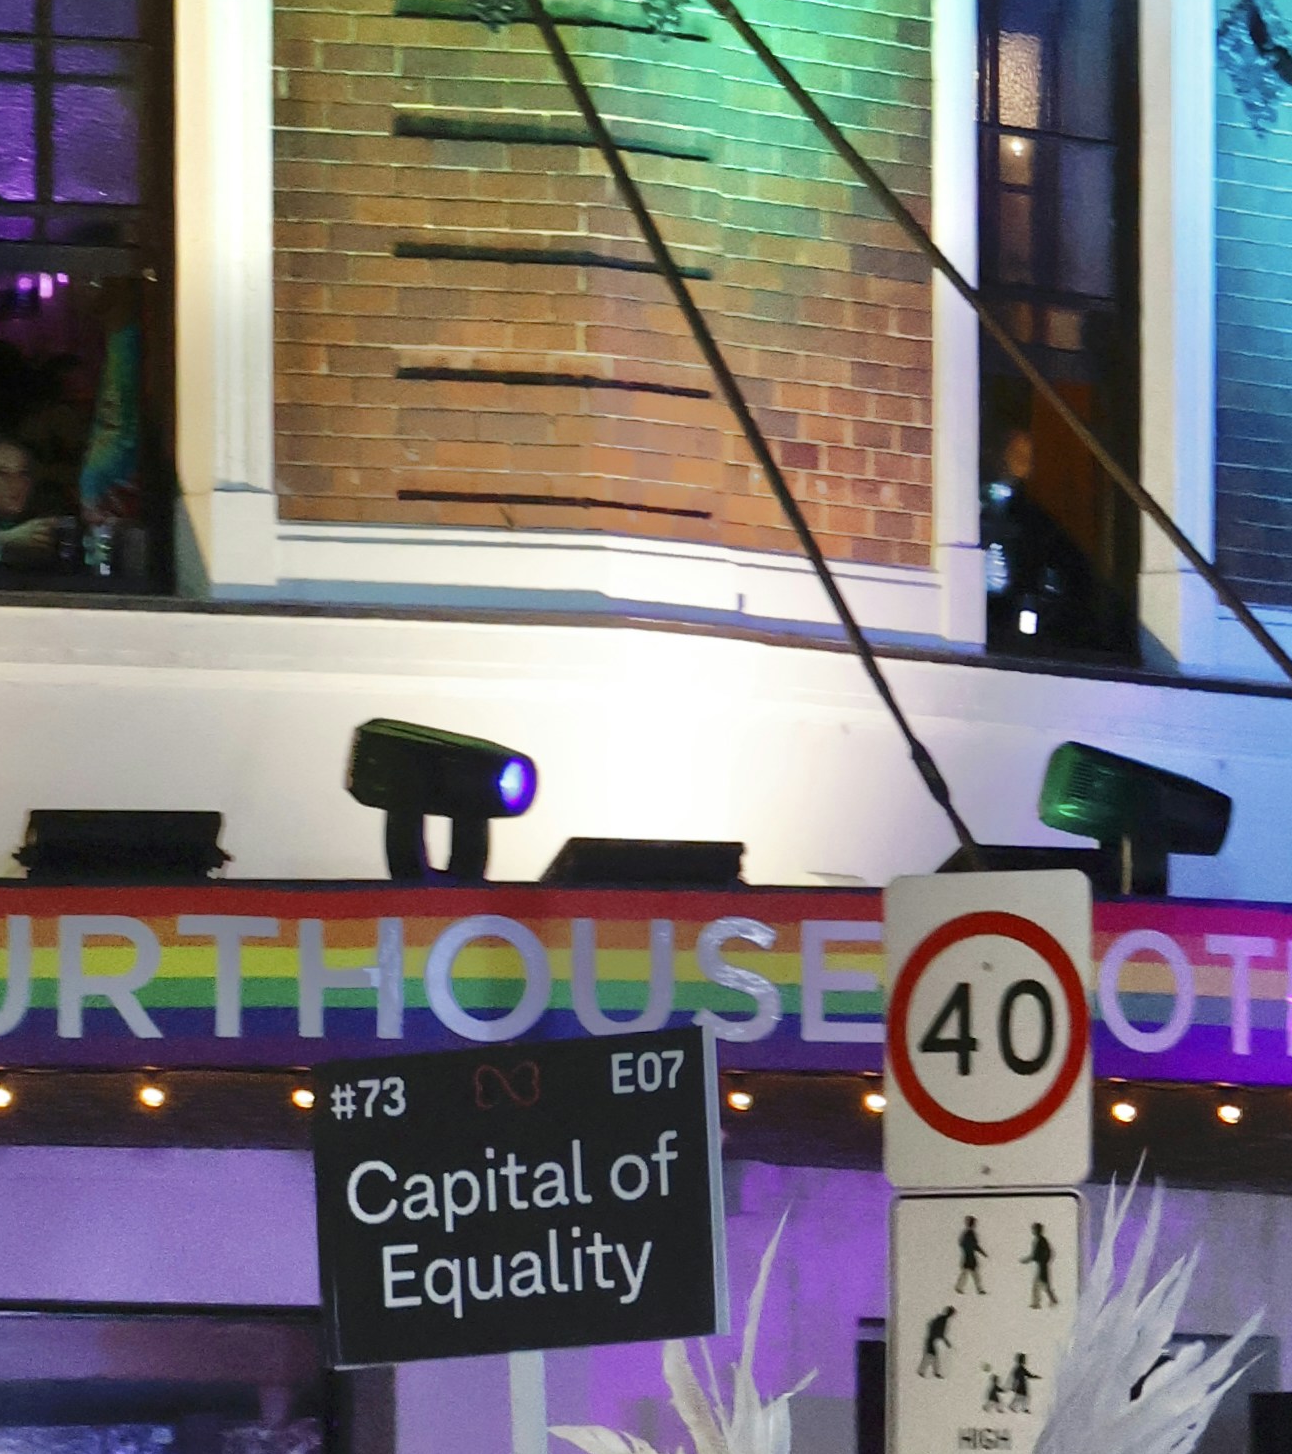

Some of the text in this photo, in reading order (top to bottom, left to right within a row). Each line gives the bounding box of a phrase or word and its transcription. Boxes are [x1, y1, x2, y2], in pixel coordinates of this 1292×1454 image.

[920, 978, 1056, 1078] 40
[330, 1049, 685, 1120] #73 E07
[346, 1129, 679, 1233] Capital of
[381, 1225, 653, 1319] Equality
